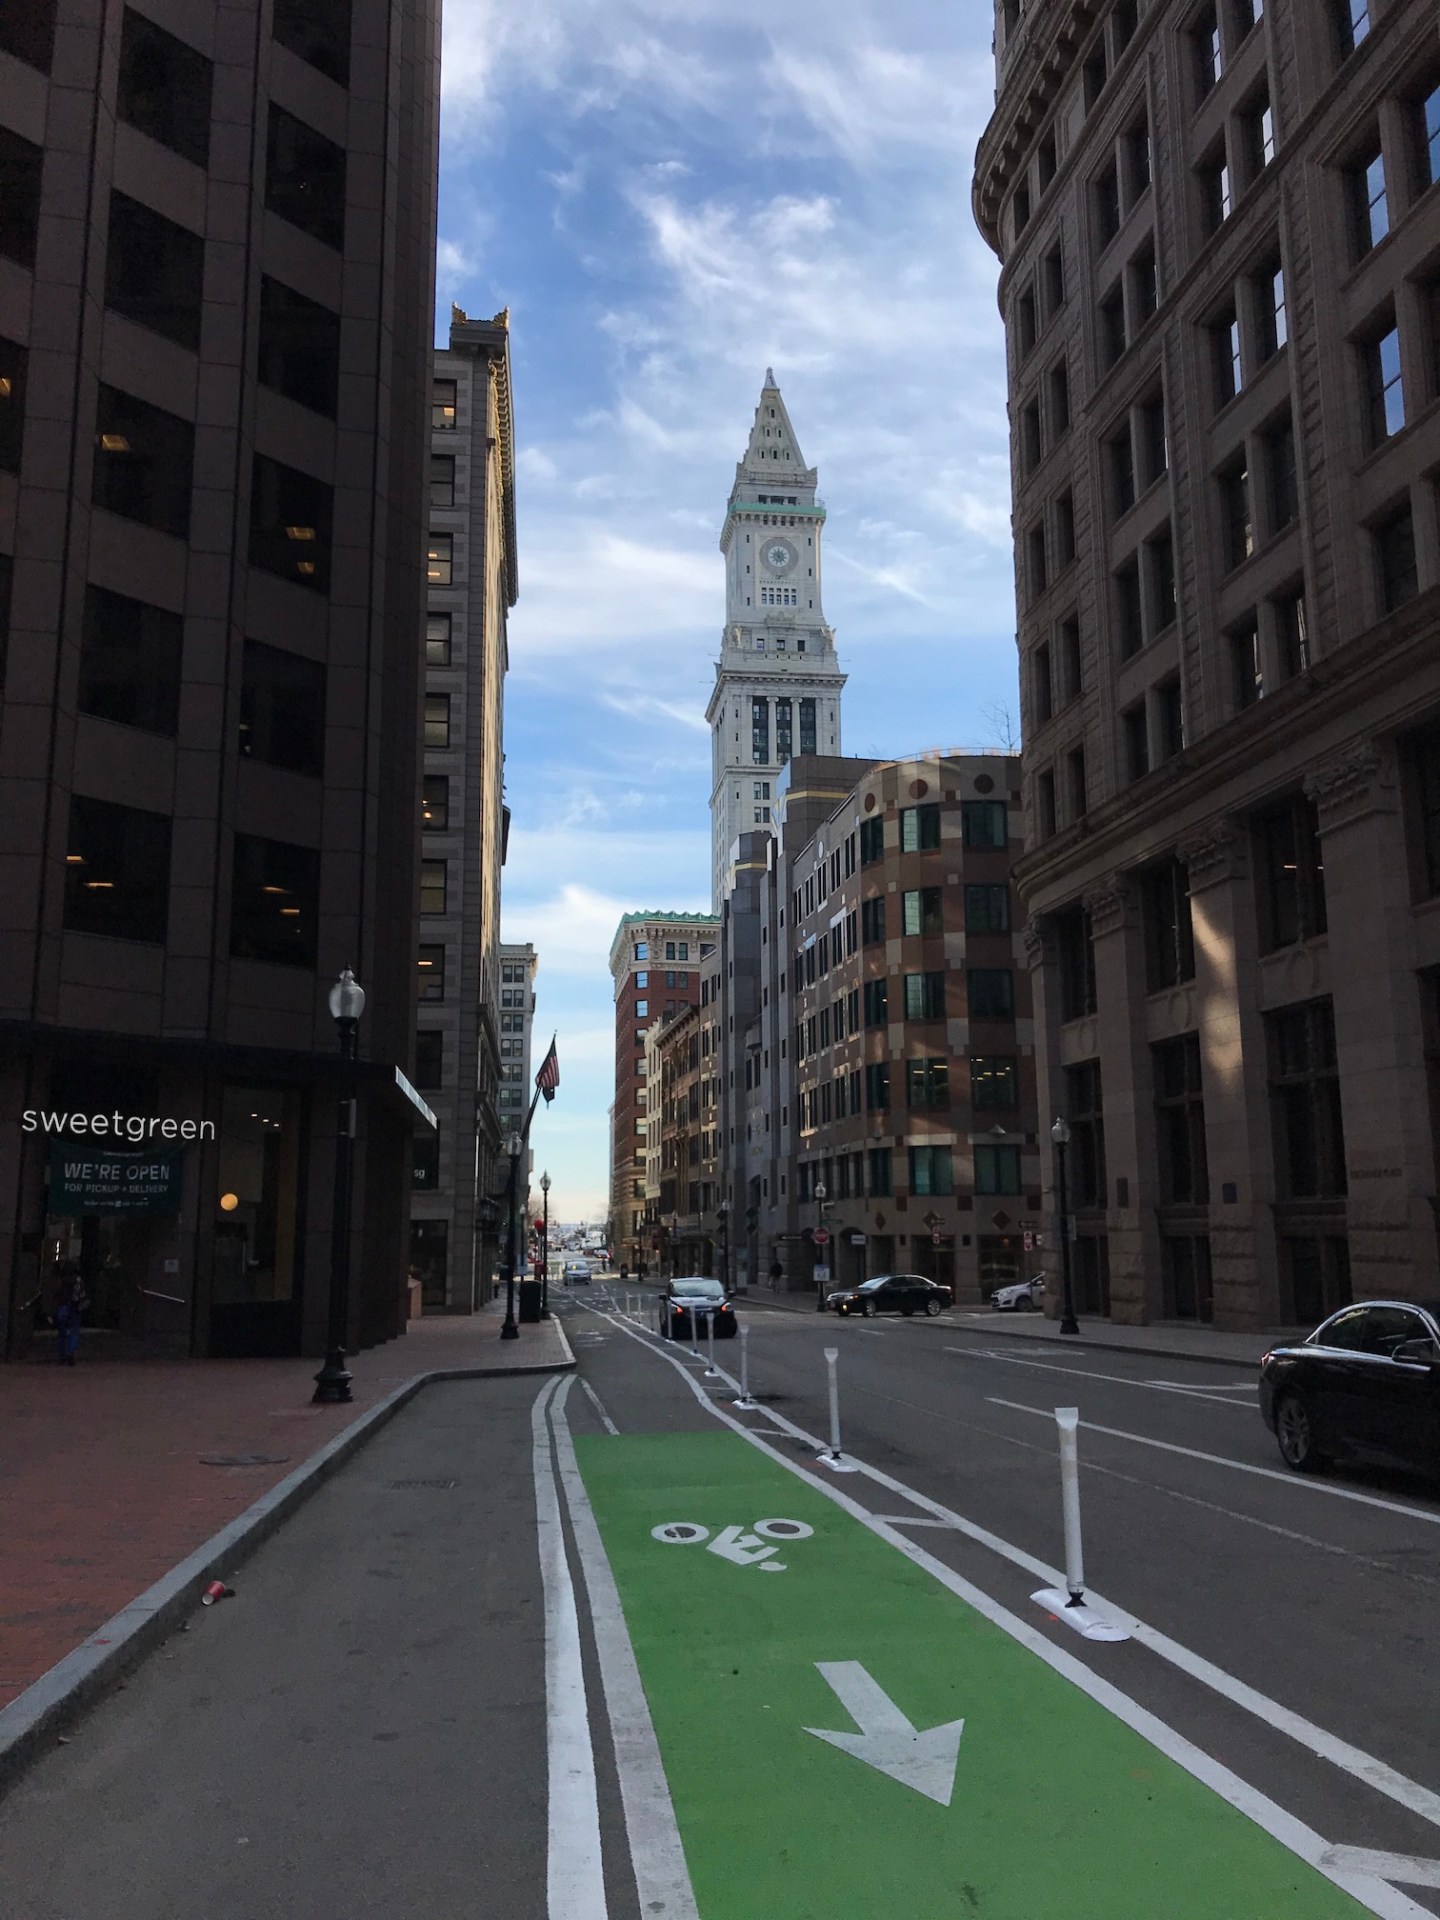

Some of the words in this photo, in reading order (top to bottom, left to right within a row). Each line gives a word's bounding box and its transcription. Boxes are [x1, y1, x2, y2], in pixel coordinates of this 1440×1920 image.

[22, 1110, 215, 1141] sweetgreen
[64, 1162, 121, 1180] WE'RE
[126, 1164, 170, 1181] OPEN
[64, 1183, 82, 1193] FOR
[86, 1183, 120, 1193] PICKUP
[129, 1184, 169, 1194] DELIVERY
